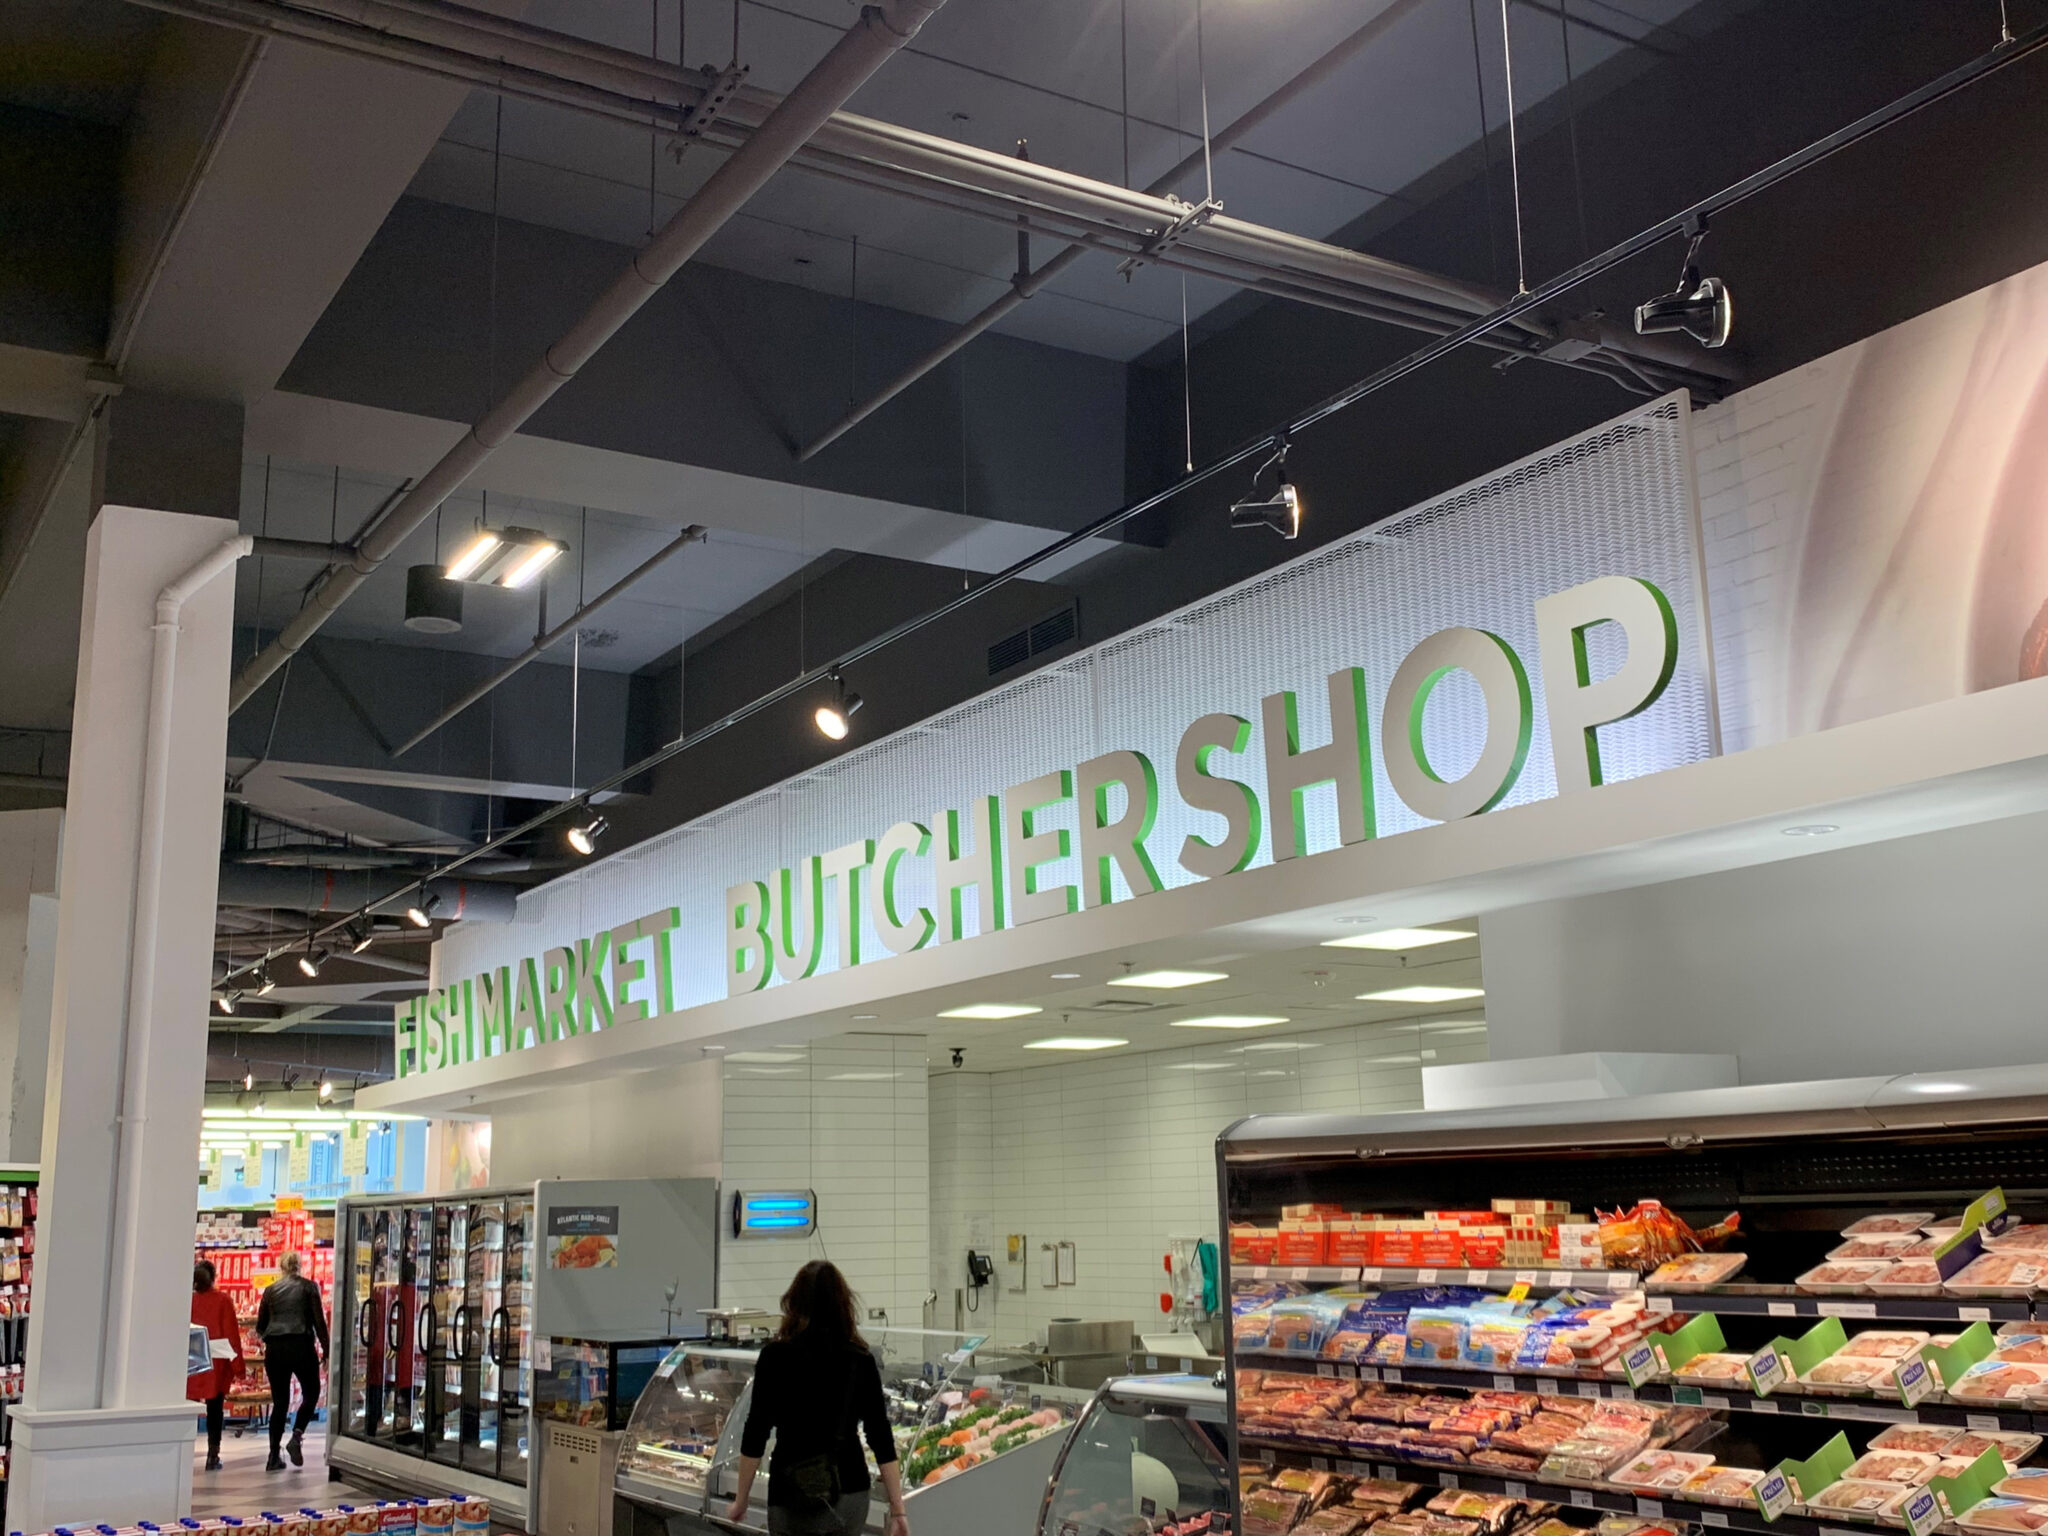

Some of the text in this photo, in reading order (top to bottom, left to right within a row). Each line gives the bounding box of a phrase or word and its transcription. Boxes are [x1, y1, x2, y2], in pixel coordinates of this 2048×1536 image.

[394, 575, 1679, 1079] FISHMARKET BUTCHERSHOP
[1911, 1497, 1932, 1520] PRIME
